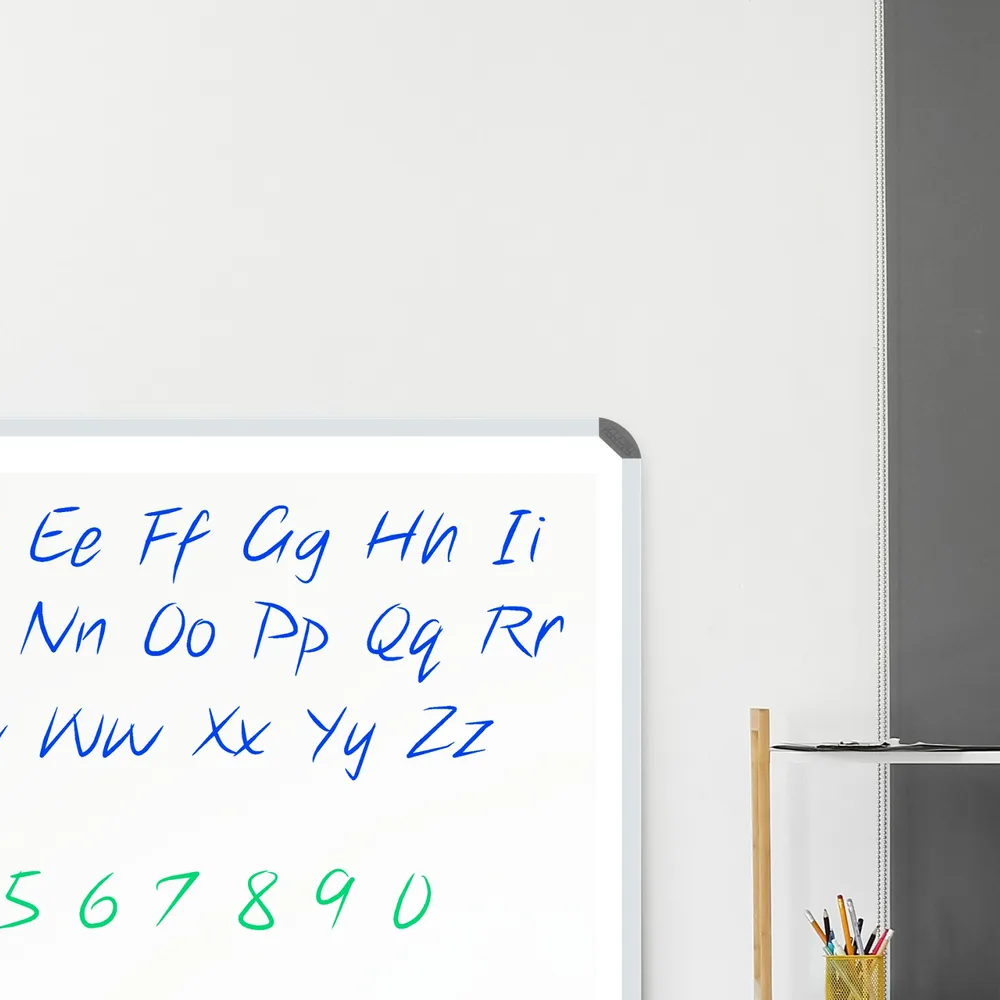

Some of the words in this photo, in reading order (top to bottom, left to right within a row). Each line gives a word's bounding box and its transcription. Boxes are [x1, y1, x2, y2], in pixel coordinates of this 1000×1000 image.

[29, 505, 103, 568] Ee
[139, 506, 211, 583] Ff
[242, 504, 331, 585] Gg
[366, 509, 458, 565] Hh
[491, 508, 546, 566] Ii
[20, 600, 107, 655] Nn
[143, 602, 216, 658] Oo
[253, 600, 329, 676] Pp
[366, 603, 444, 684] Qq
[481, 604, 565, 659] Rr
[39, 706, 163, 759] Ww
[191, 706, 272, 758] Xx
[306, 706, 377, 782] Yy
[405, 705, 495, 759] Zz
[78, 871, 119, 930] 6
[155, 871, 201, 927] 7
[237, 869, 279, 931] 8
[315, 867, 356, 928] 9
[392, 872, 433, 930] 0
